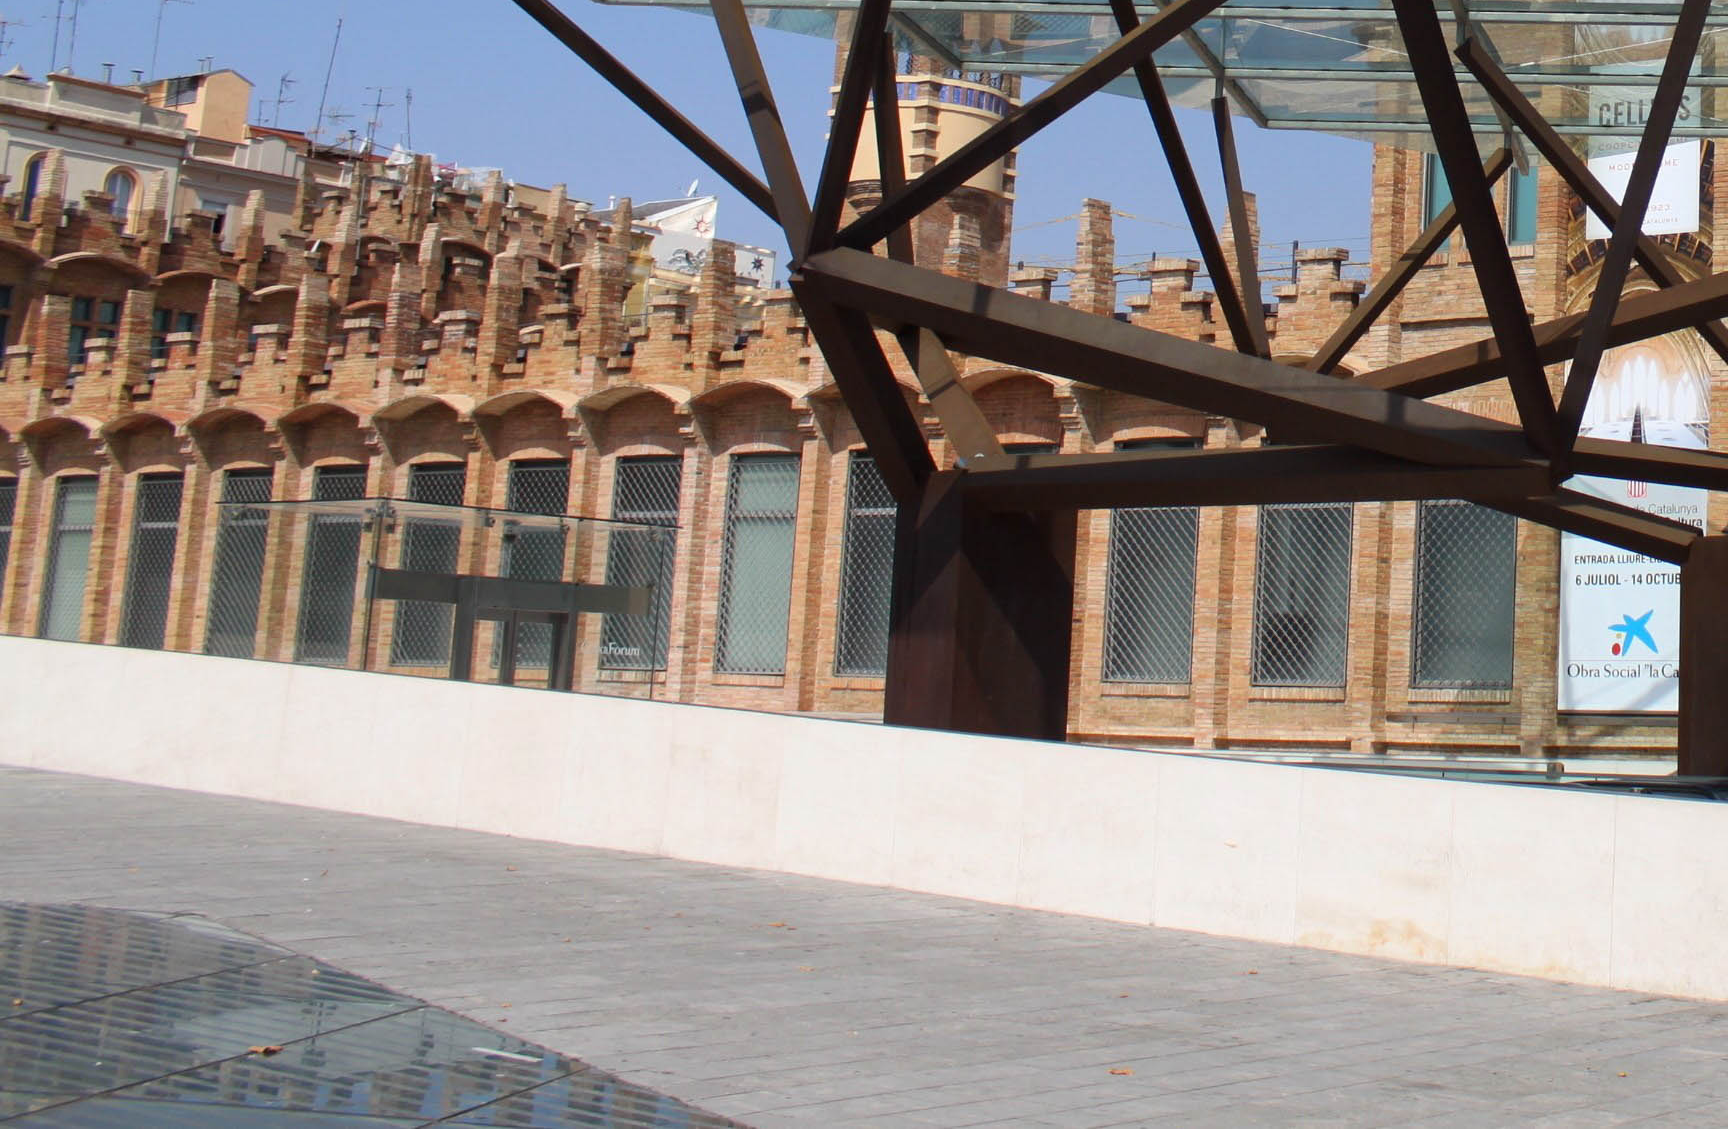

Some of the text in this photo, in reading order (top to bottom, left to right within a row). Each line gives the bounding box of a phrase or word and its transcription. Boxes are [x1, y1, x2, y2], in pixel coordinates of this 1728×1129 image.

[1648, 503, 1698, 516] Catalunya
[1574, 554, 1615, 564] ENTRADA
[1576, 574, 1582, 586] 6
[1584, 574, 1621, 586] JULIOL
[1632, 574, 1643, 586] 14
[1646, 573, 1681, 585] OCTUB
[1568, 664, 1600, 678] Obra
[1604, 663, 1640, 678] Social
